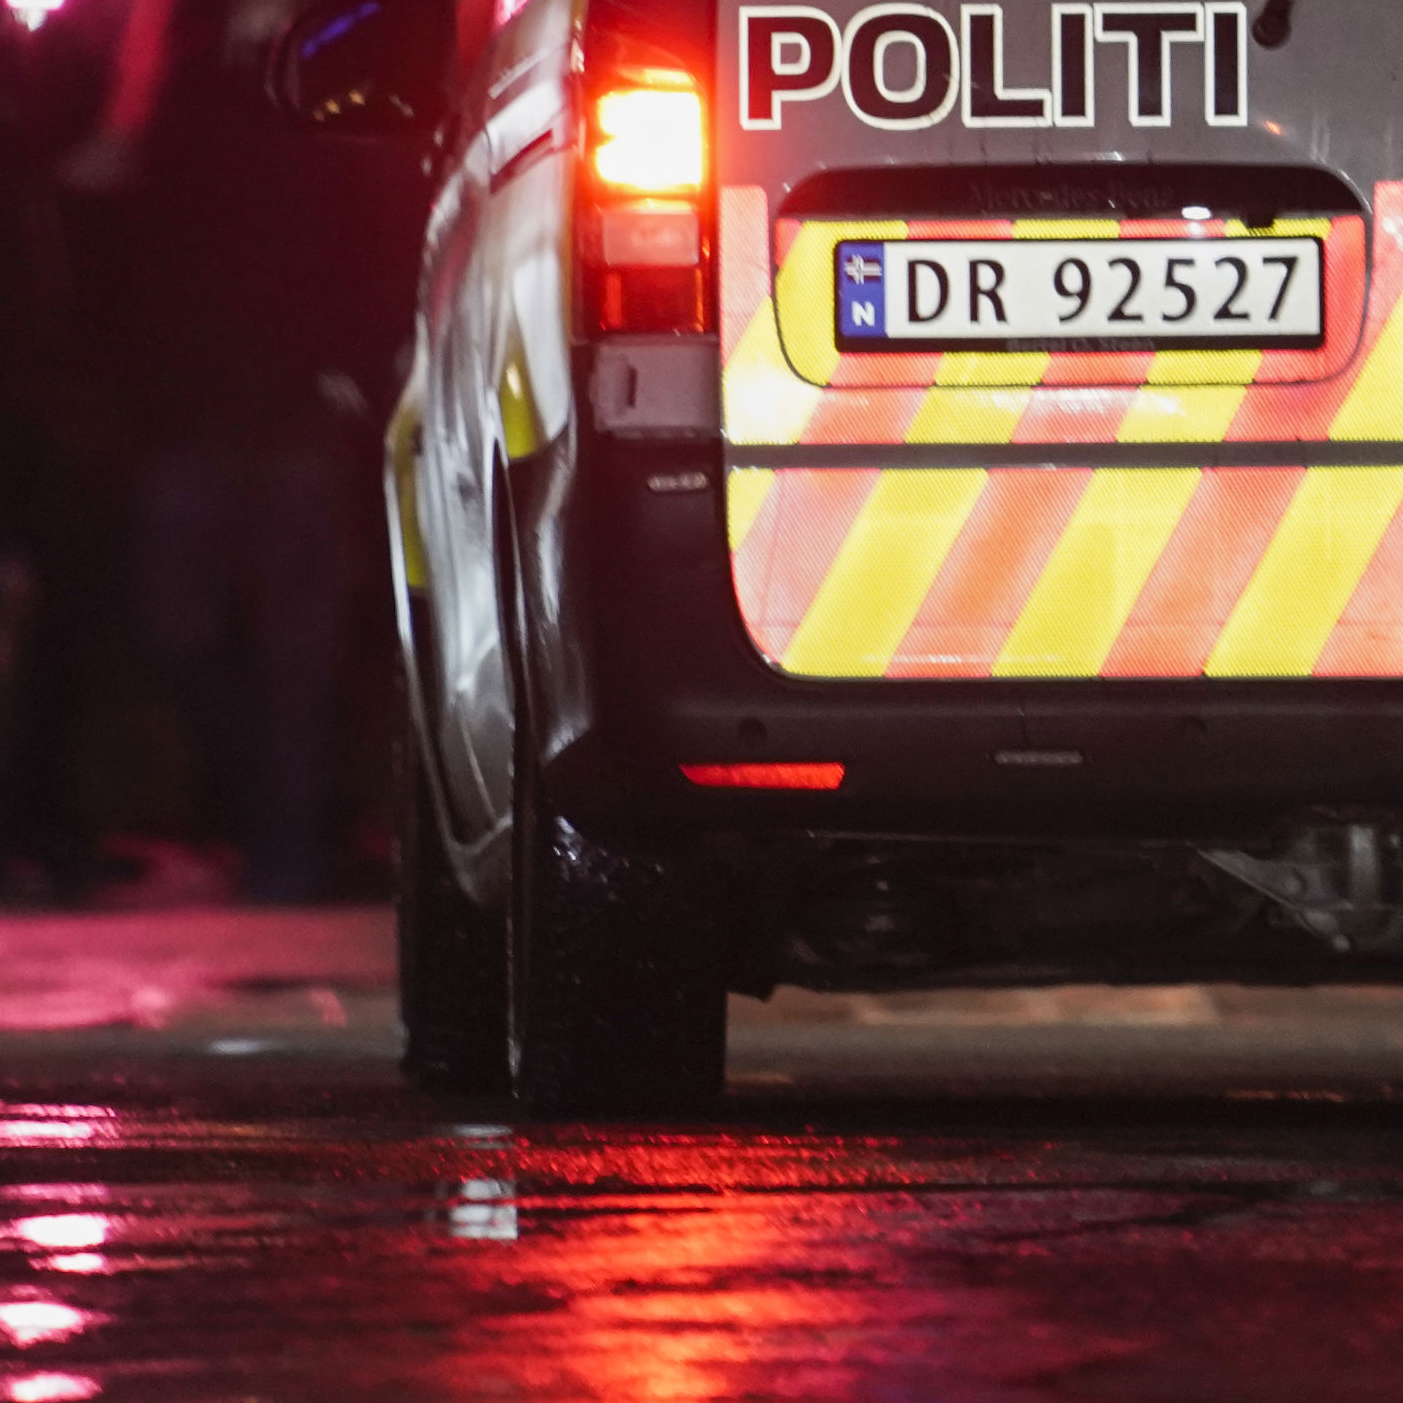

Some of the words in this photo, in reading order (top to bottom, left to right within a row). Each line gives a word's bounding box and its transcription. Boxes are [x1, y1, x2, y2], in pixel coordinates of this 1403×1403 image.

[739, 2, 1247, 130] POLITI
[851, 301, 875, 326] N
[907, 259, 1006, 324] DR
[1054, 257, 1298, 323] 92527
